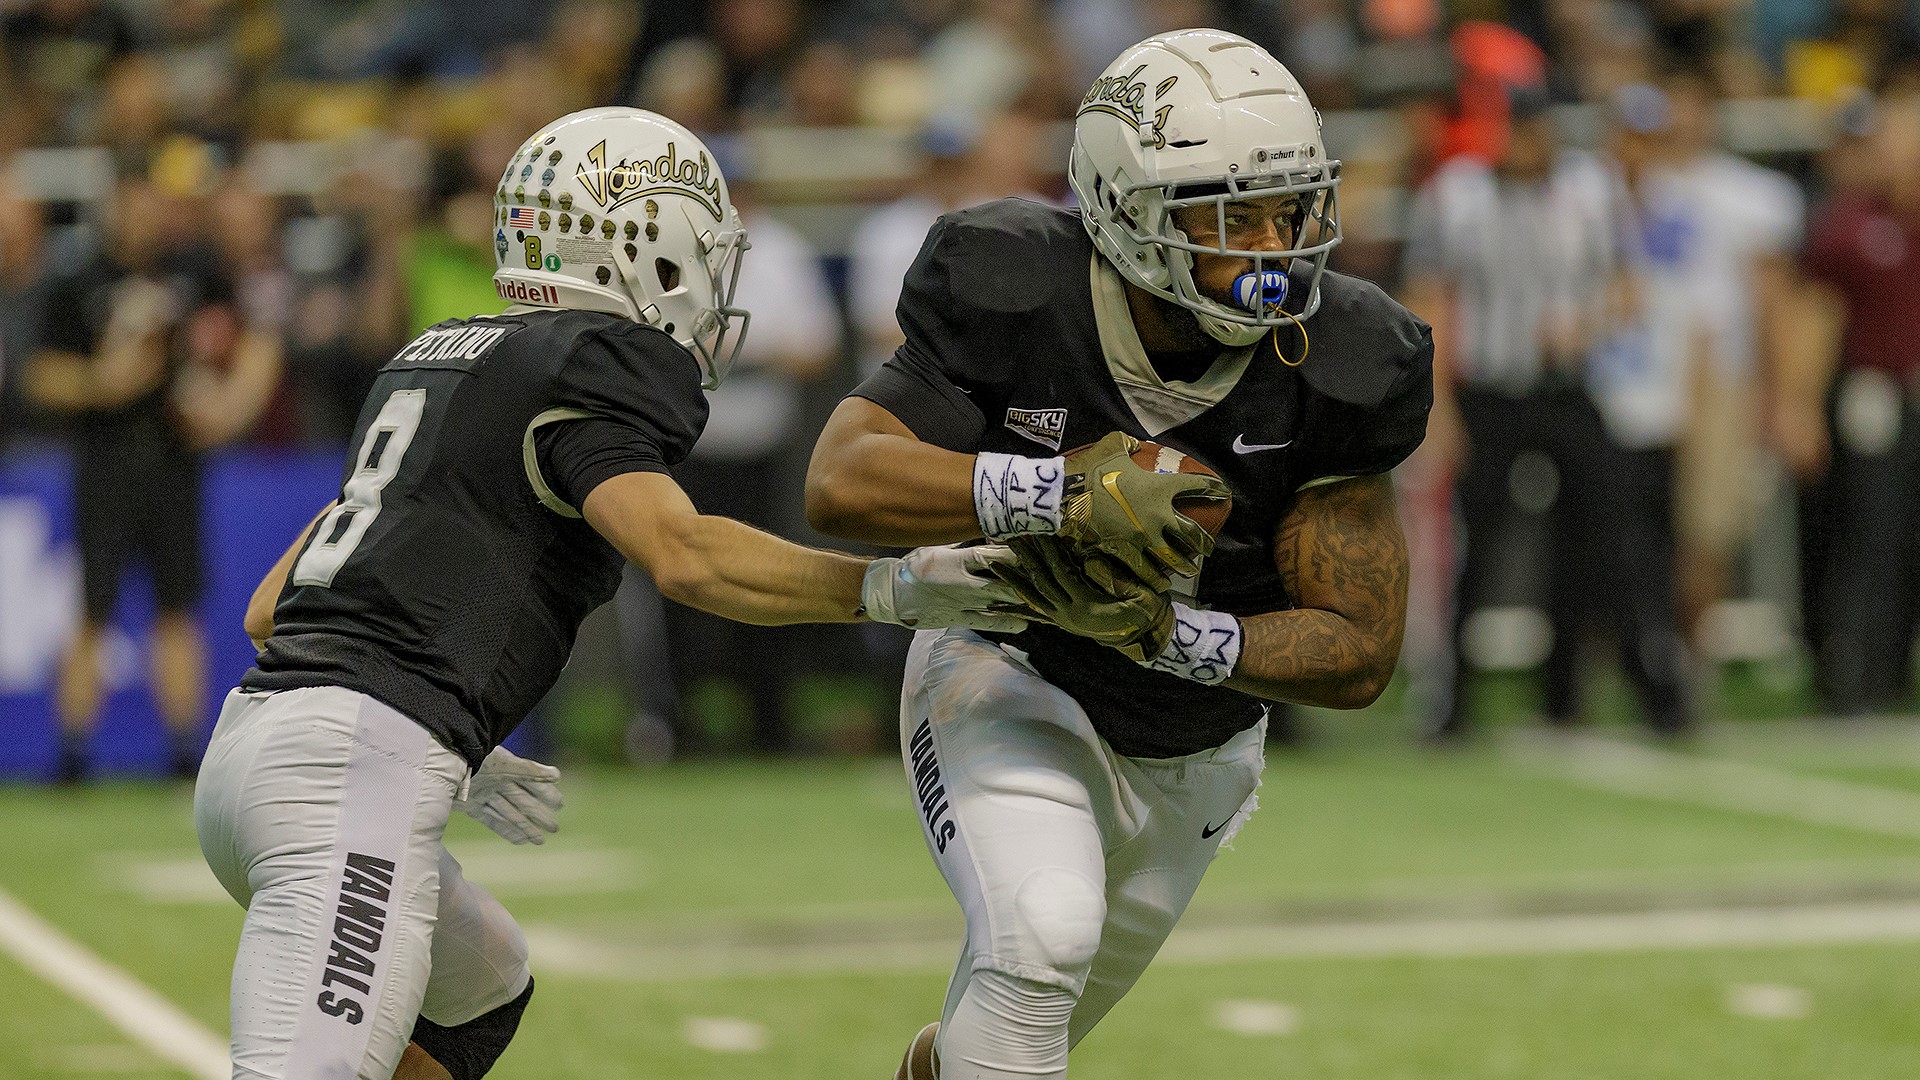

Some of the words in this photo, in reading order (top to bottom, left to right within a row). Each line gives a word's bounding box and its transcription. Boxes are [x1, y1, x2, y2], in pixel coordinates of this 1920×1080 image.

[1083, 64, 1178, 149] andals
[576, 139, 722, 222] Vandals
[493, 279, 559, 304] Riddell
[525, 235, 543, 270] 8
[293, 388, 427, 588] 8
[1009, 471, 1034, 533] RIP
[910, 717, 956, 855] VANDALS
[317, 852, 396, 1026] VANDALS
